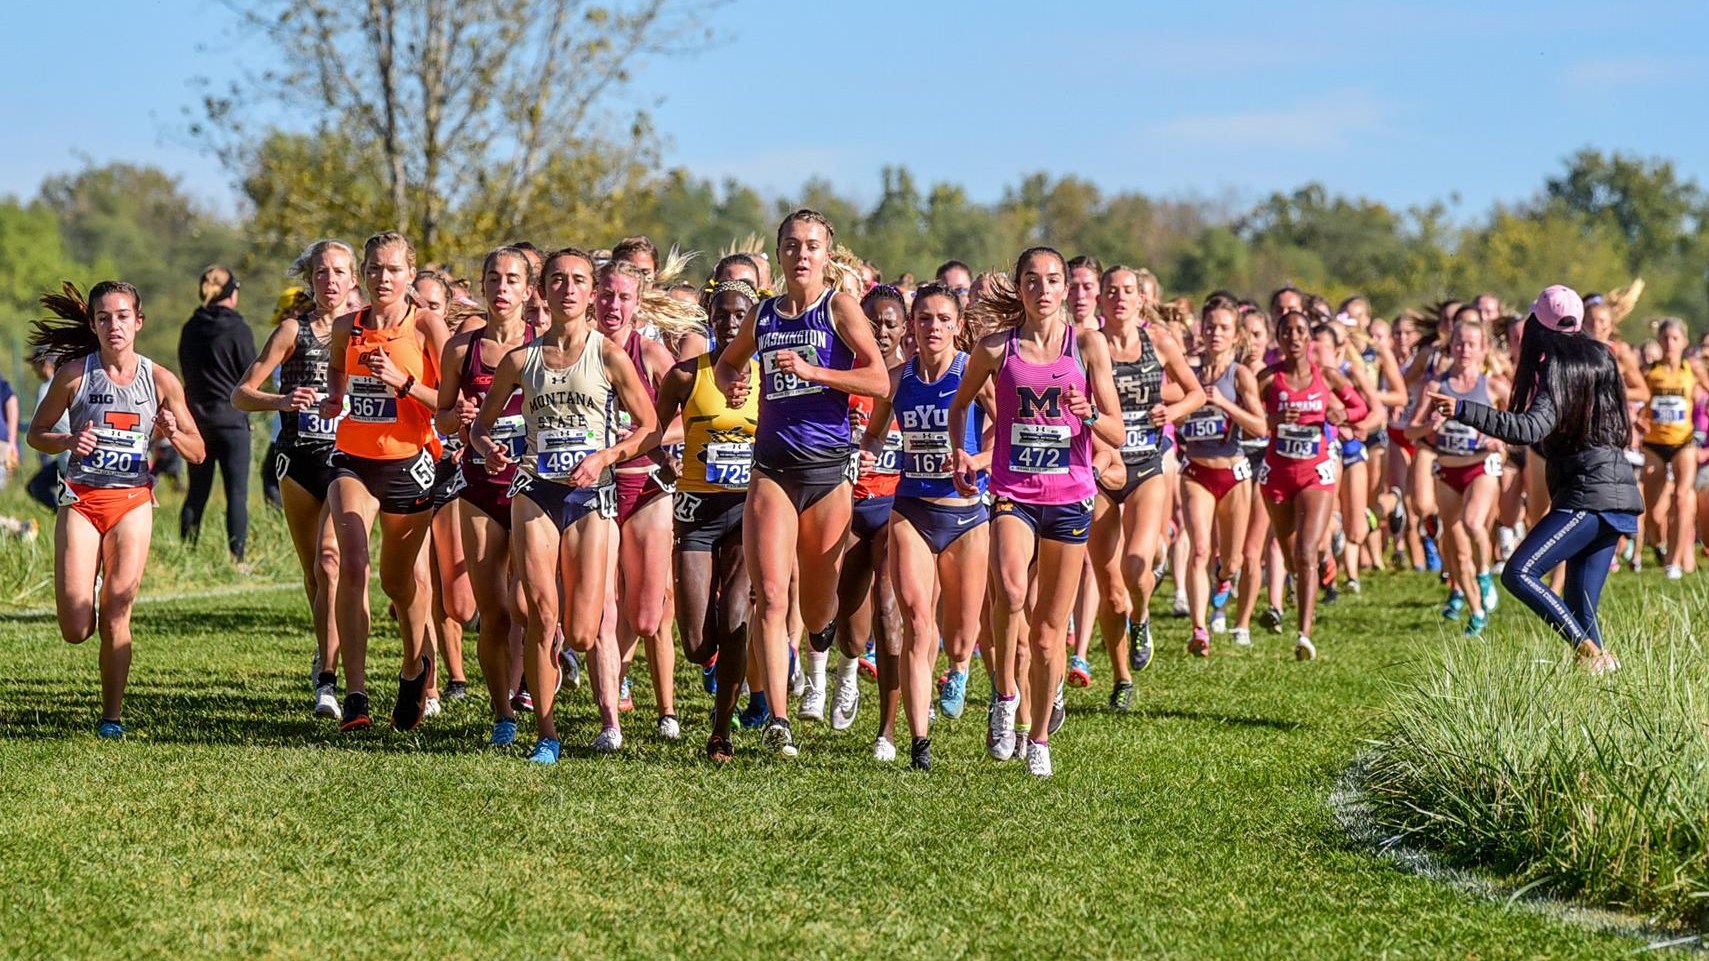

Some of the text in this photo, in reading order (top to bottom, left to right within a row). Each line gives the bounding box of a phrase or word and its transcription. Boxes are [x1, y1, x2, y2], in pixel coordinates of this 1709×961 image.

[758, 330, 827, 350] WASHINGTON
[88, 394, 114, 404] BIG
[353, 398, 384, 417] 567
[529, 391, 595, 414] MONTANA
[1016, 385, 1062, 418] M
[308, 414, 336, 434] 30
[538, 414, 587, 429] STATE
[903, 404, 949, 429] BYU
[1123, 430, 1149, 447] 05
[1285, 440, 1313, 456] 103
[91, 449, 132, 472] 320
[912, 454, 947, 473] 167
[1018, 447, 1060, 468] 472
[715, 464, 751, 484] 725
